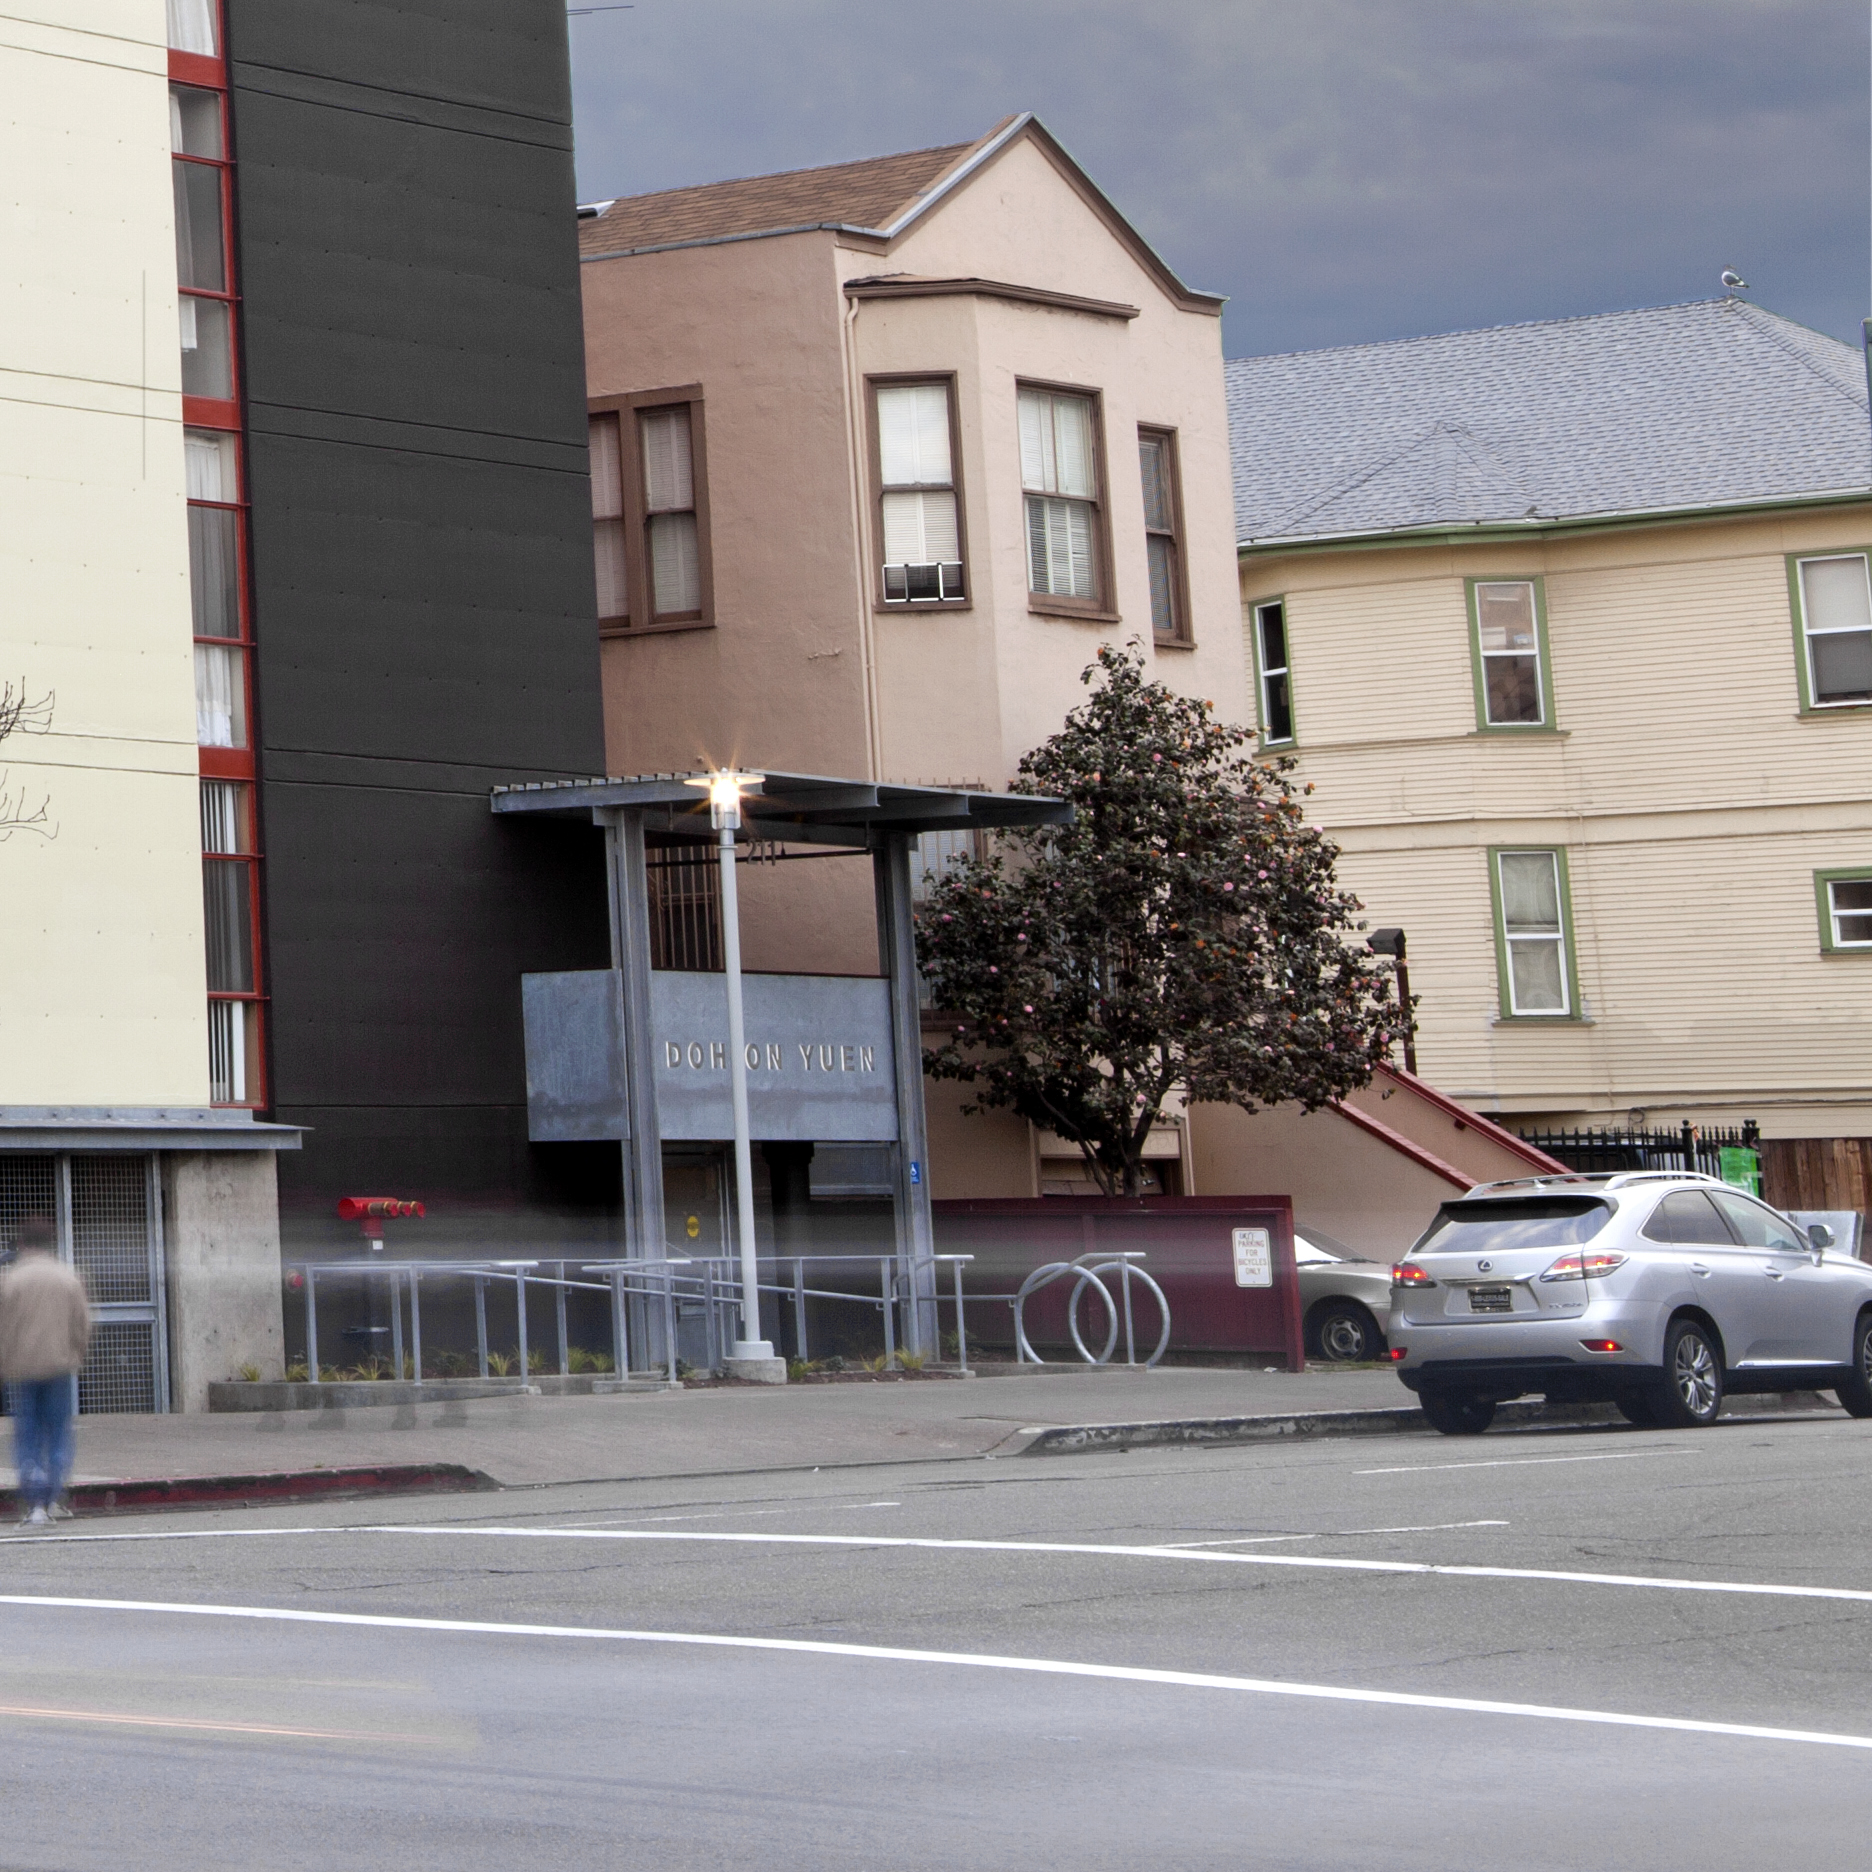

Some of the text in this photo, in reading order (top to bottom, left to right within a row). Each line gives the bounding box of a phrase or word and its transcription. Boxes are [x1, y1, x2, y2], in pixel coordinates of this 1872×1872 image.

[665, 1041, 875, 1072] DOH ON YUEN
[1238, 1240, 1265, 1248] PARKING
[1246, 1267, 1261, 1275] ONLY
